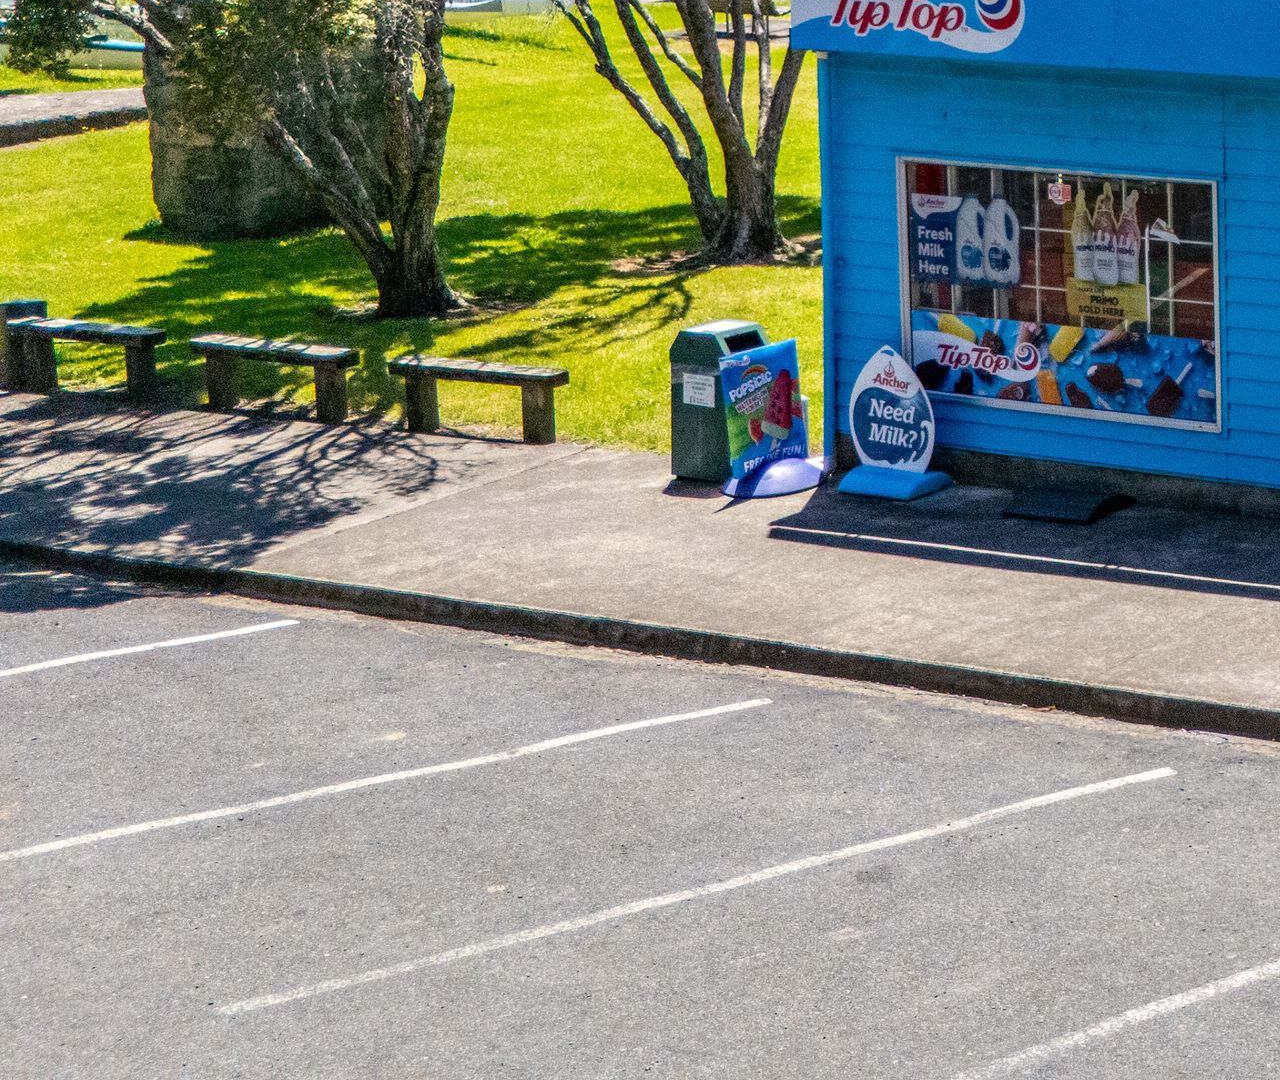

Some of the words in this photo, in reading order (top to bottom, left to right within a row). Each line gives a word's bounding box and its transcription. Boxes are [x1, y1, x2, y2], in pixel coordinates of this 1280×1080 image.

[917, 226, 953, 241] Fresh
[918, 243, 945, 258] Milk
[919, 260, 949, 275] Here
[1078, 305, 1101, 314] SOLD
[1103, 307, 1125, 317] HERE
[872, 373, 911, 390] Anchor
[869, 398, 915, 424] Need
[869, 423, 917, 448] Milk?
